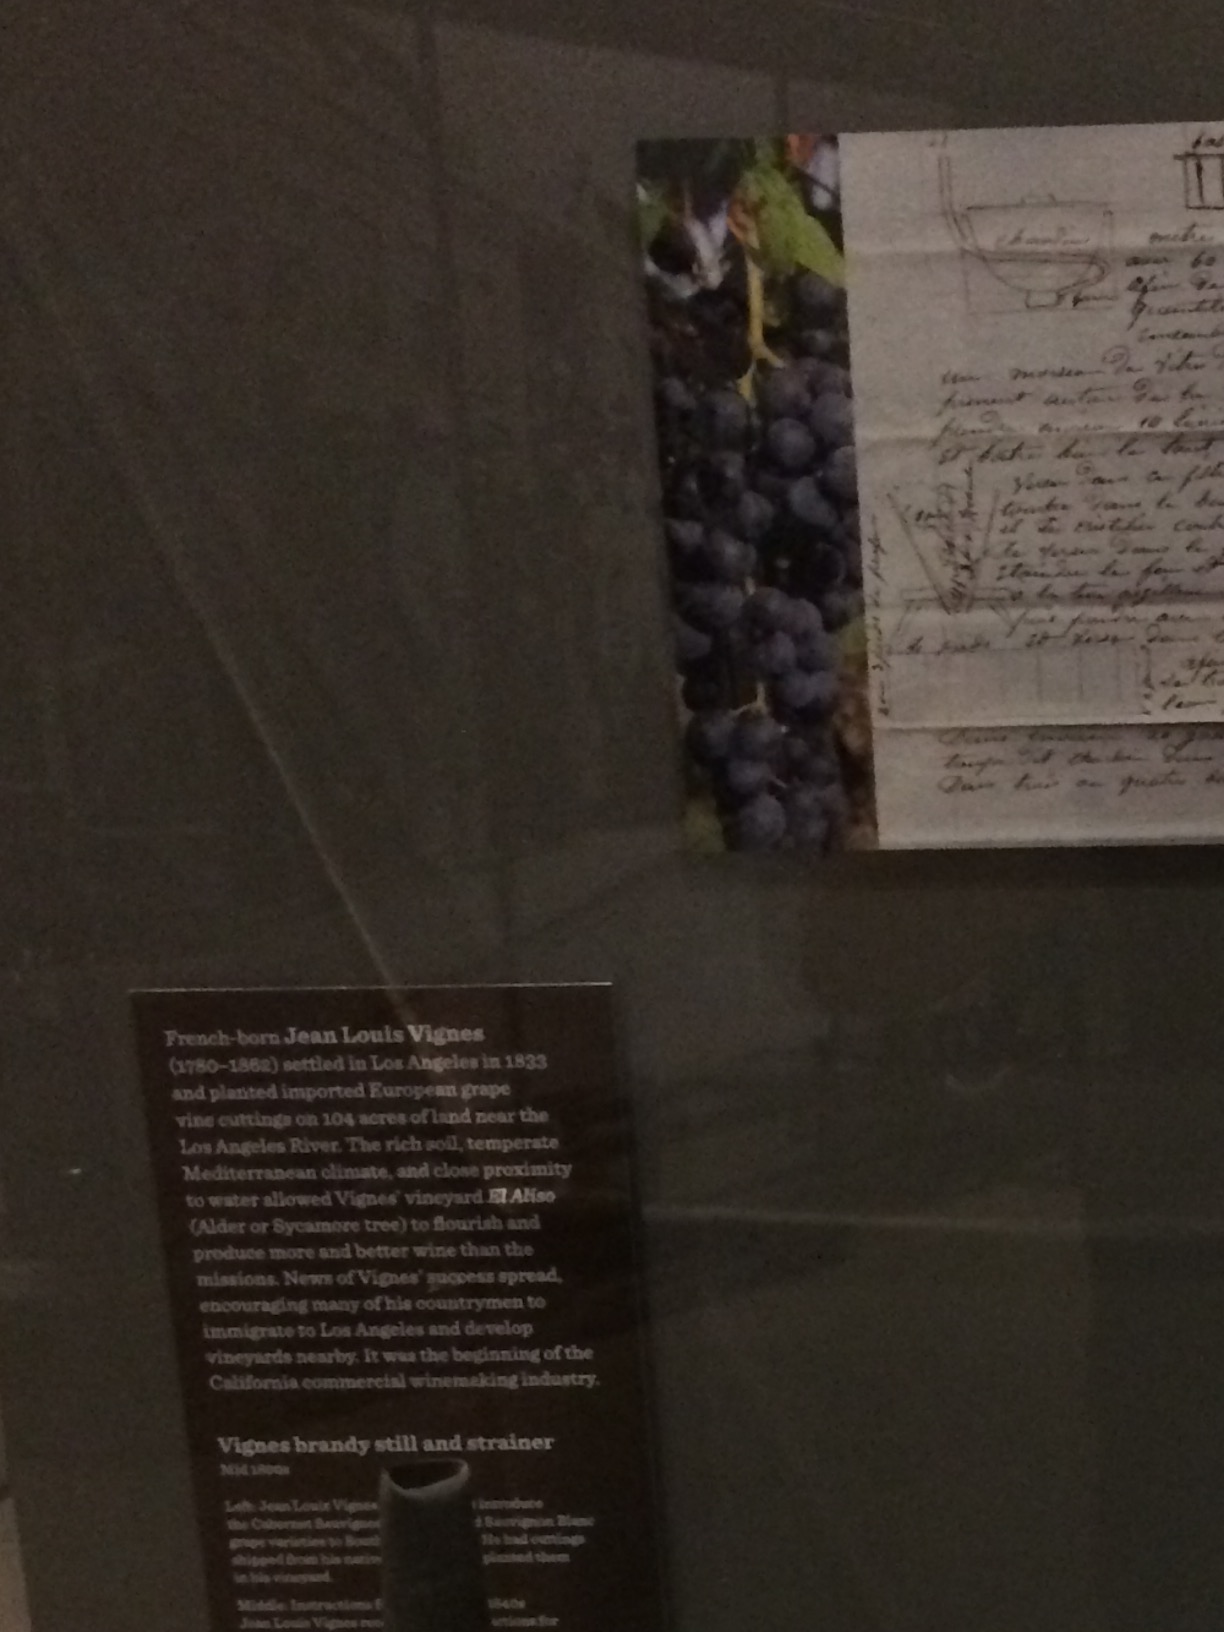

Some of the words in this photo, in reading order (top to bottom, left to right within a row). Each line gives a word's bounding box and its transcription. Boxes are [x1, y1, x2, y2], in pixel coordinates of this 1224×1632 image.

[164, 1027, 280, 1046] French-born
[283, 1026, 336, 1045] Jean
[342, 1025, 404, 1044] Louis
[406, 1025, 485, 1048] Vignes
[282, 1056, 345, 1073] settled
[348, 1056, 367, 1072] in
[369, 1055, 404, 1072] Los
[406, 1055, 478, 1076] Angeles
[481, 1054, 500, 1071] in
[504, 1054, 548, 1070] 1833
[172, 1084, 206, 1101] and
[208, 1084, 278, 1105] planted
[281, 1083, 365, 1104] imported
[368, 1082, 457, 1103] European
[460, 1085, 511, 1102] grape
[175, 1112, 215, 1128] vine
[217, 1111, 292, 1132] cuttings
[295, 1115, 319, 1127] on
[322, 1110, 355, 1126] 104
[358, 1114, 407, 1126] acres
[409, 1109, 430, 1125] of
[431, 1109, 472, 1125] land
[475, 1113, 515, 1125] near
[518, 1108, 549, 1124] the
[178, 1138, 214, 1155] Los
[215, 1137, 286, 1159] Angeles
[289, 1137, 341, 1153] River.
[347, 1136, 382, 1153] The
[384, 1136, 423, 1152] rich
[425, 1135, 463, 1156] soil,
[467, 1134, 560, 1156] temperate
[182, 1164, 318, 1181] Mediterranean
[320, 1163, 392, 1184] climate,
[396, 1162, 430, 1179] and
[433, 1162, 479, 1178] close
[483, 1161, 573, 1182] proximity
[186, 1192, 205, 1208] to
[208, 1191, 260, 1208] water
[262, 1191, 332, 1207] allowed
[403, 1189, 483, 1210] vineyard
[488, 1188, 508, 1205] El
[509, 1188, 557, 1204] Aliso
[189, 1218, 246, 1239] (Alder
[249, 1222, 270, 1234] or
[272, 1217, 360, 1238] Sycamore
[364, 1216, 408, 1233] tree)
[409, 1216, 430, 1232] to
[433, 1215, 504, 1232] flourish
[507, 1215, 541, 1231] and
[192, 1244, 266, 1264] produce
[268, 1247, 315, 1259] more
[318, 1243, 351, 1259] and
[353, 1243, 409, 1259] better
[412, 1242, 456, 1258] wine
[459, 1242, 501, 1258] than
[503, 1242, 535, 1258] the
[196, 1269, 280, 1286] missions.
[282, 1269, 333, 1285] News
[336, 1268, 357, 1285] of
[426, 1272, 496, 1284] success
[498, 1267, 563, 1288] spread,
[199, 1296, 309, 1318] encouraging
[312, 1300, 361, 1317] many
[363, 1295, 383, 1312] of
[384, 1295, 412, 1311] his
[414, 1294, 525, 1316] countrymen
[527, 1293, 547, 1310] to
[202, 1323, 295, 1343] immigrate
[297, 1323, 317, 1338] to
[319, 1322, 351, 1338] Los
[354, 1322, 425, 1342] Angeles
[428, 1321, 462, 1337] and
[464, 1321, 534, 1341] develop
[204, 1348, 293, 1369] vineyards
[296, 1347, 360, 1368] nearby.
[364, 1347, 381, 1363] It
[383, 1351, 417, 1363] was
[419, 1346, 450, 1362] the
[452, 1346, 541, 1366] beginning
[543, 1345, 563, 1361] of
[564, 1345, 594, 1361] the
[209, 1374, 299, 1391] California
[302, 1373, 407, 1390] commercial
[408, 1372, 520, 1393] winemaking
[521, 1371, 601, 1392] industry.
[217, 1437, 292, 1459] Vignes
[293, 1436, 372, 1458] brandy
[374, 1435, 418, 1452] still
[422, 1435, 463, 1452] and
[465, 1434, 556, 1451] strainer
